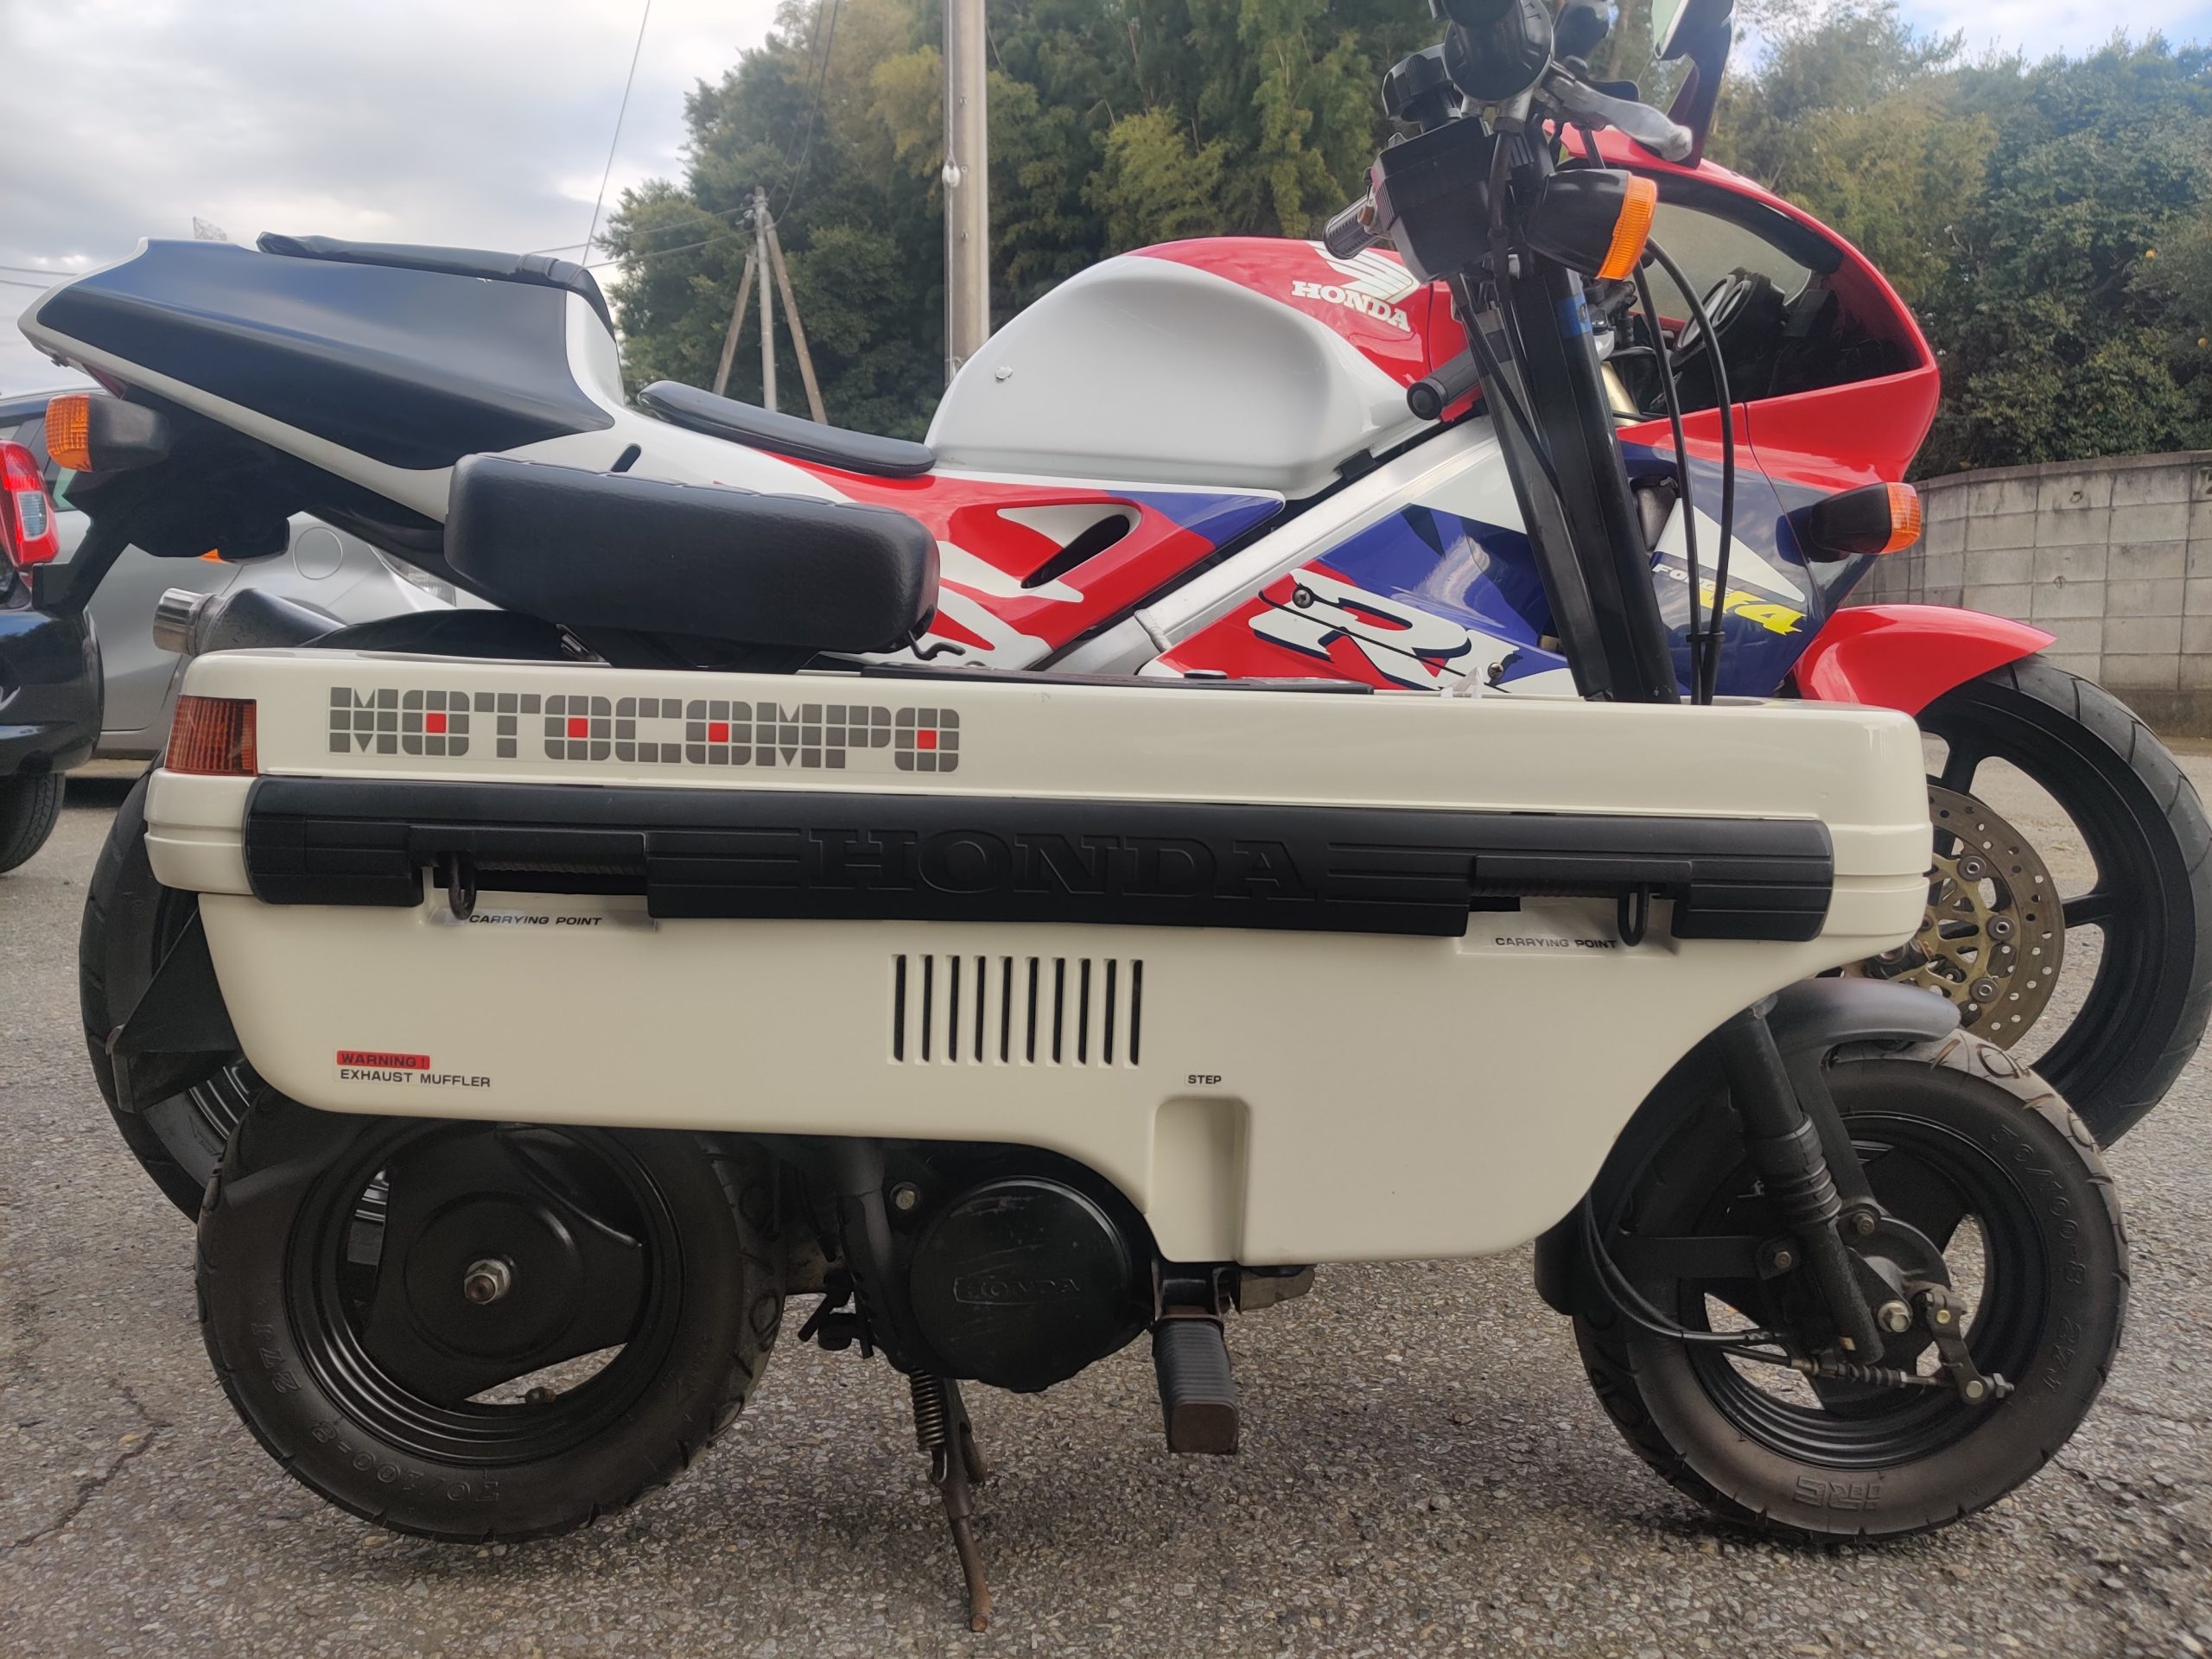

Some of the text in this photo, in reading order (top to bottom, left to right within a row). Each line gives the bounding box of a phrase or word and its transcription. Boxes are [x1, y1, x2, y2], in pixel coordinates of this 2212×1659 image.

[1292, 280, 1410, 333] HONDA
[329, 687, 959, 772] MOTOCOMPO
[808, 829, 1317, 902] HONDA
[469, 915, 602, 925] CARRYING POINT
[1495, 938, 1569, 947] CARRYING
[342, 1053, 416, 1067] WARNING
[340, 1069, 490, 1087] EXHAUST MUFFLER
[1188, 1075, 1222, 1084] STEP
